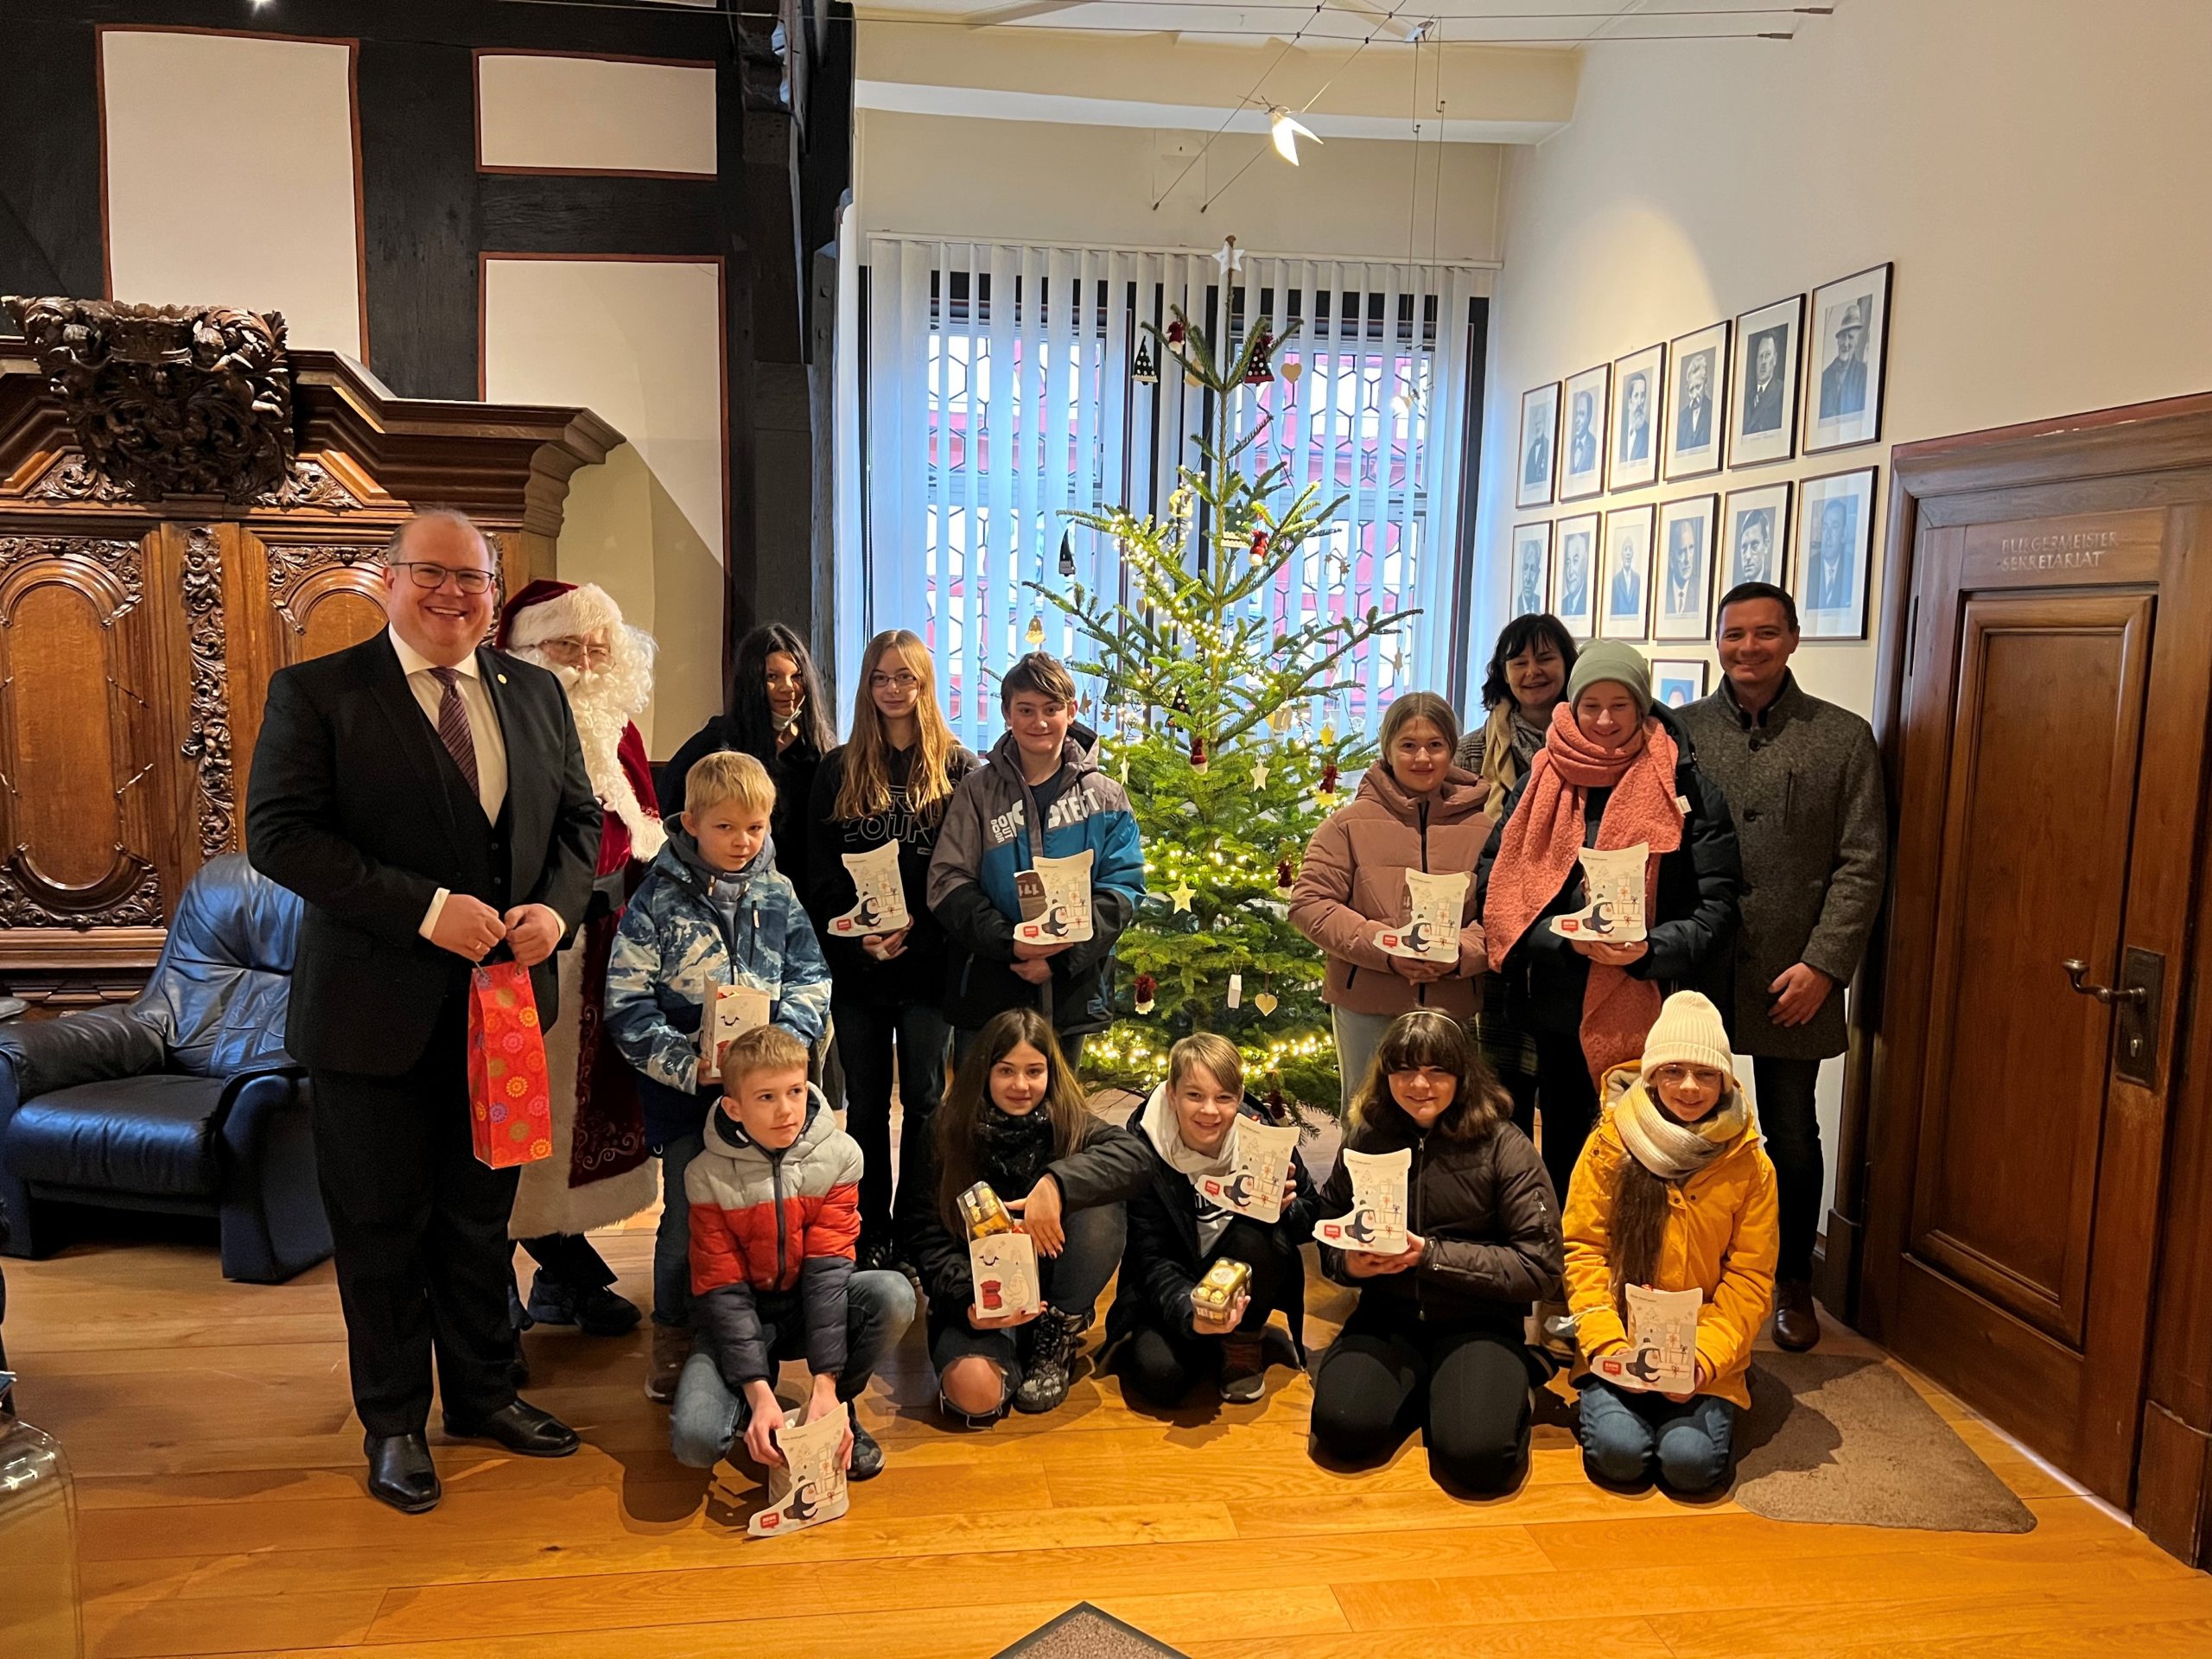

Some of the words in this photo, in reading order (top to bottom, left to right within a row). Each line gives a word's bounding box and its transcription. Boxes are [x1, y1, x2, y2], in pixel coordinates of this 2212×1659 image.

[2001, 550, 2105, 571] SEKRETARIAT
[990, 818, 1005, 843] DOOR
[997, 815, 1014, 839] OUT
